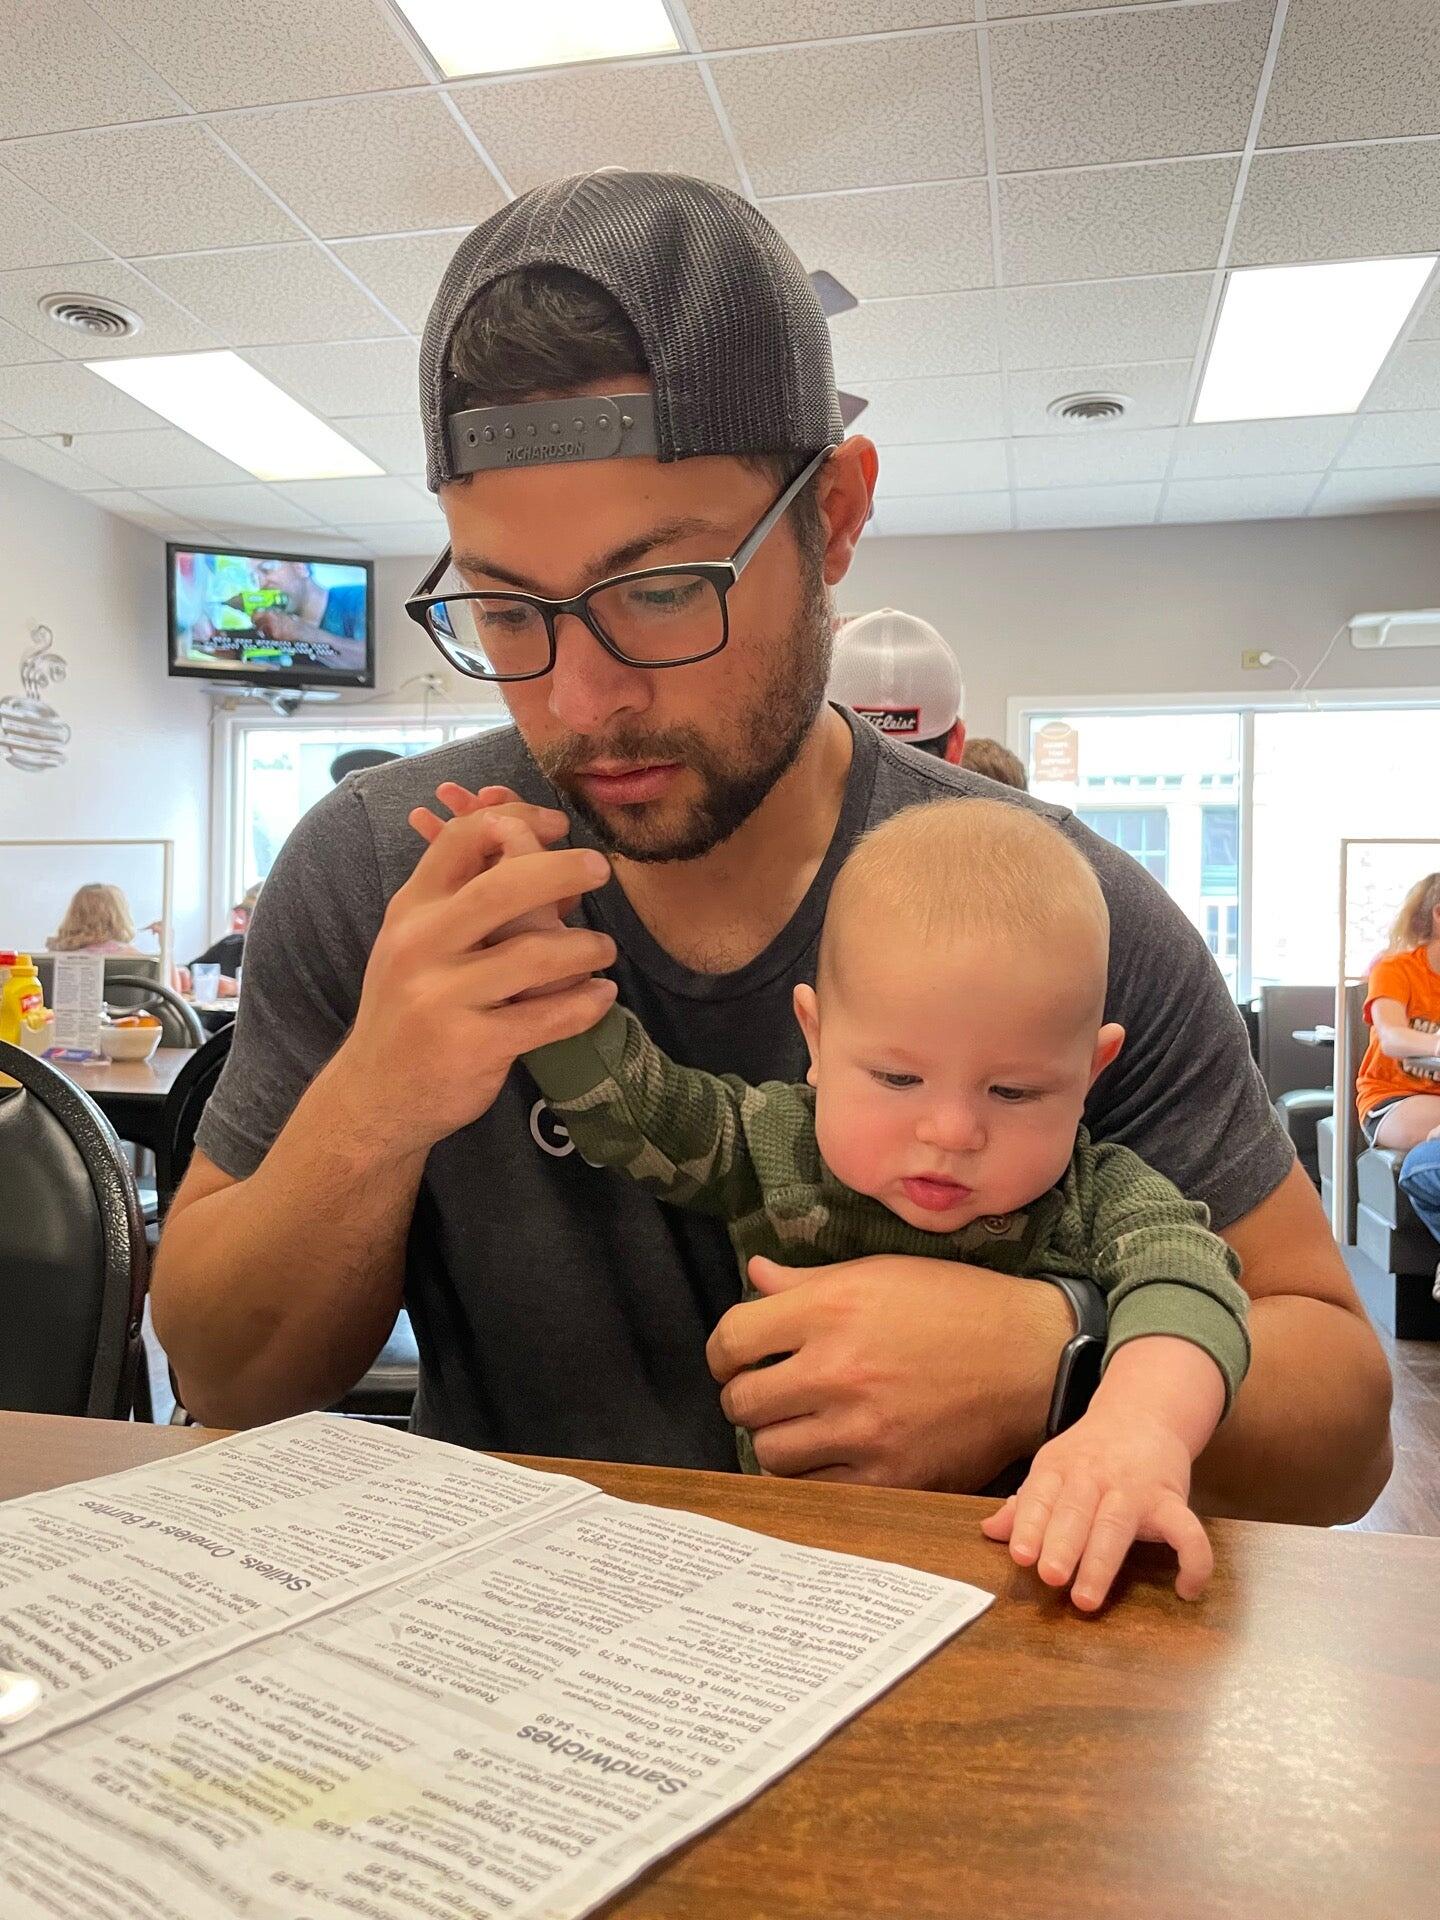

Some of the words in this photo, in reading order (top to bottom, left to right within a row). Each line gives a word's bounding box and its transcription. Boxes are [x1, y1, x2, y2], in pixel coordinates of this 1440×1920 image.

[504, 441, 586, 462] RICHARDSON
[79, 1501, 147, 1525] Burritos
[618, 1520, 670, 1541] Sandwich
[159, 1525, 235, 1558] Omelets
[376, 1536, 414, 1551] Denver
[577, 1534, 617, 1551] Delight
[620, 1541, 669, 1559] Breaded
[671, 1538, 703, 1552] Steak
[360, 1548, 389, 1561] Meat
[618, 1547, 663, 1565] Chicken
[704, 1548, 745, 1564] Ribeye
[240, 1554, 311, 1591] Skillets,
[590, 1558, 639, 1576] Breaded
[590, 1565, 636, 1584] Chicken
[664, 1563, 716, 1581] Avocado
[683, 1561, 723, 1576] Grilled
[637, 1580, 685, 1598] Western
[867, 1577, 889, 1588] Dip
[481, 1590, 515, 1606] Philly
[755, 1588, 796, 1603] Bacon
[833, 1588, 872, 1603] Monte
[890, 1584, 933, 1601] French
[528, 1604, 564, 1619] Philly
[597, 1591, 655, 1614] California
[679, 1605, 704, 1615] with
[732, 1601, 765, 1614] $6.99
[798, 1597, 850, 1615] Chicken
[871, 1599, 914, 1616] Grilled
[79, 1607, 105, 1623] Chip
[179, 1616, 205, 1633] Chip
[462, 1613, 517, 1636] Sandwich
[563, 1614, 613, 1635] Chicken
[587, 1614, 623, 1629] Steak
[705, 1613, 755, 1634] Chicken
[784, 1614, 834, 1633] Chicken
[850, 1612, 899, 1630] Grilled
[865, 1609, 904, 1625] Swiss
[125, 1624, 170, 1646] Dough
[151, 1615, 189, 1638] Peanut
[405, 1625, 439, 1640] $6.99
[772, 1625, 807, 1639] $6.99
[836, 1628, 878, 1644] Alpine
[103, 1620, 154, 1653] Chocolate
[513, 1631, 544, 1643] Beef
[665, 1635, 697, 1649] Pork
[756, 1629, 802, 1646] Buffalo
[62, 1632, 118, 1669] Strawberry
[97, 1639, 133, 1662] Cream
[455, 1642, 503, 1662] Reuben
[544, 1638, 581, 1657] Italian
[696, 1646, 742, 1664] Grilled
[802, 1642, 858, 1661] Breaded
[827, 1639, 867, 1654] Swiss
[598, 1649, 632, 1666] $6.79
[396, 1660, 432, 1677] $6.99
[502, 1658, 544, 1680] Turkey
[650, 1667, 696, 1685] Cheese
[703, 1668, 742, 1683] $6.99
[757, 1656, 828, 1682] Tenderloin
[761, 1667, 822, 1688] Breaded
[449, 1679, 499, 1703] Reuben
[579, 1670, 632, 1693] Chicken
[561, 1691, 612, 1711] Cheese
[632, 1689, 680, 1709] Grilled
[710, 1684, 741, 1699] Ham
[765, 1687, 800, 1703] Gyro
[283, 1700, 327, 1719] Burger
[740, 1694, 786, 1713] Grilled
[535, 1713, 575, 1731] $4.99
[611, 1708, 660, 1730] Grilled
[699, 1710, 762, 1733] Breaded
[722, 1705, 772, 1725] Breast
[259, 1721, 303, 1742] Burger
[324, 1715, 360, 1735] Toast
[662, 1726, 684, 1738] Up
[596, 1736, 650, 1760] Cheese
[625, 1731, 666, 1749] $6.79
[686, 1732, 736, 1753] Grown
[228, 1737, 273, 1763] Burger
[303, 1739, 371, 1771] Impossible
[453, 1748, 493, 1769] $7.99
[686, 1751, 721, 1766] BLT
[517, 1726, 686, 1795] Sandwiches
[650, 1756, 703, 1778] Grilled
[272, 1760, 335, 1792] California
[513, 1771, 565, 1794] Burger
[208, 1777, 292, 1821] Lumberjack
[565, 1788, 641, 1821] Breakfast
[422, 1790, 516, 1832] Smokehouse
[475, 1799, 518, 1819] $7.99
[517, 1826, 582, 1858] Cowboy
[539, 1822, 597, 1847] Burger
[430, 1839, 485, 1869] Burger
[485, 1864, 538, 1892] House
[465, 1880, 514, 1908] Bacon
